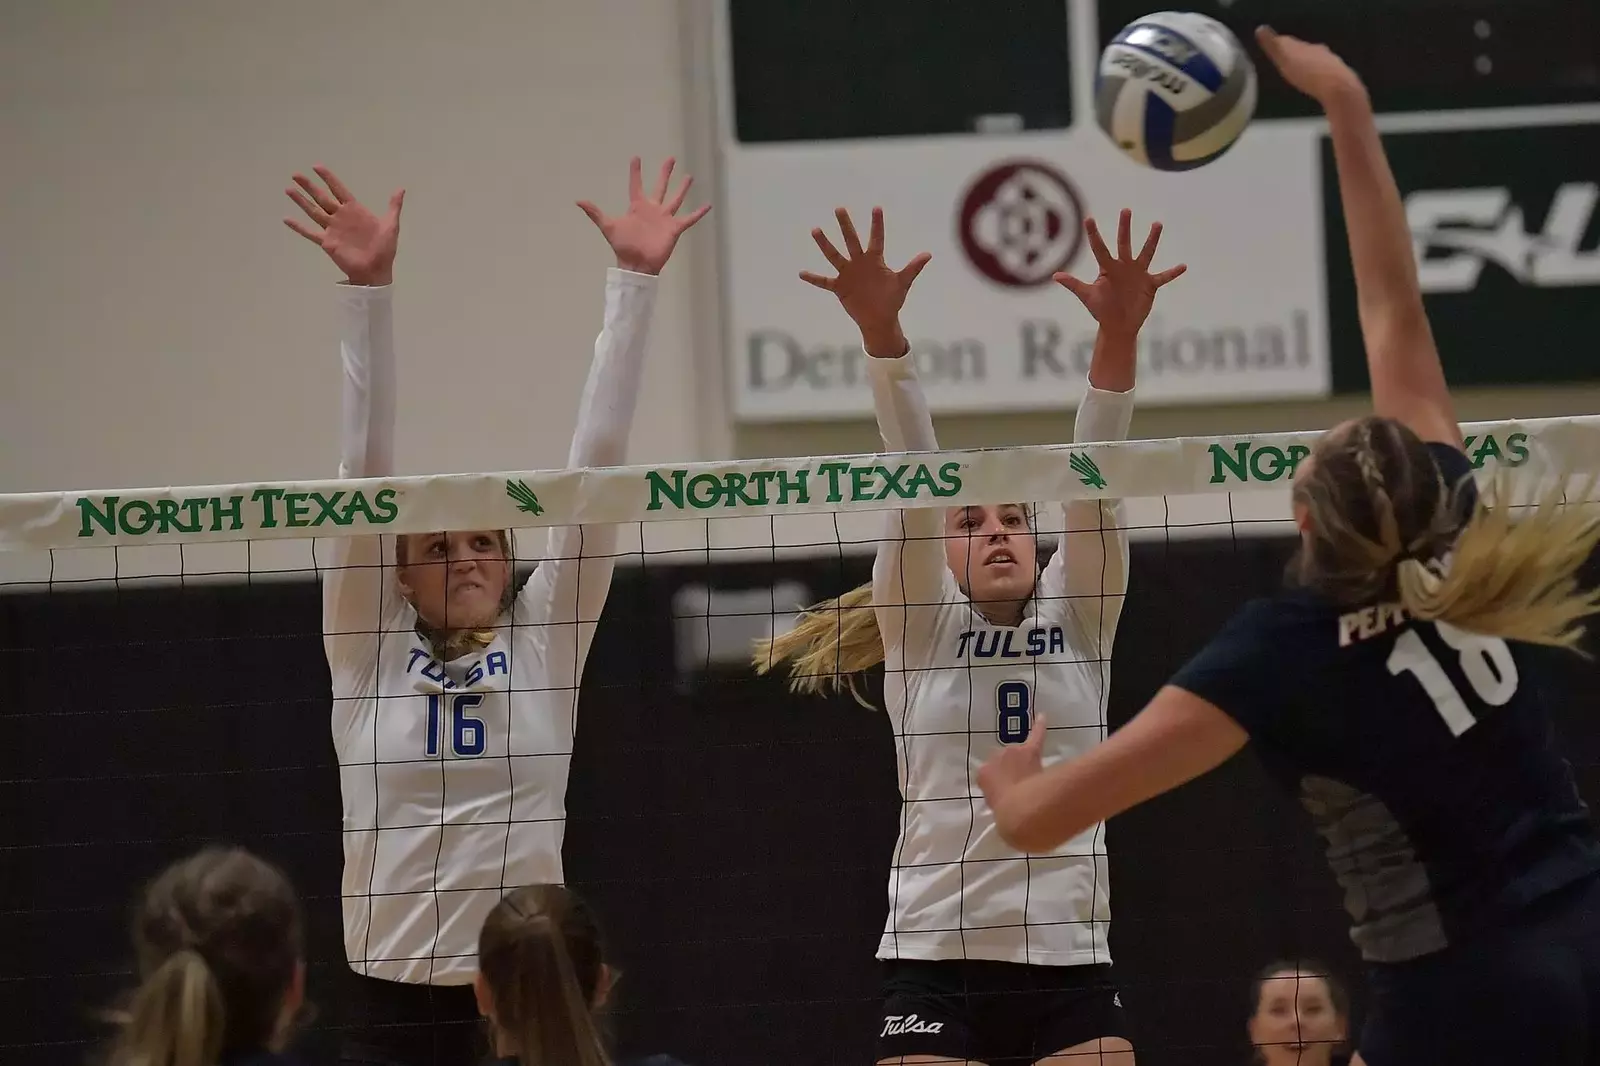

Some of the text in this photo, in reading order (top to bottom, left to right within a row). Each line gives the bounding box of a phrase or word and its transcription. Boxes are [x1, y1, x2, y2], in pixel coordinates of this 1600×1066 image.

[644, 461, 963, 510] NORTH TEXAS
[75, 488, 398, 537] NORTH TEXAS
[956, 626, 1065, 659] TULSA
[424, 692, 487, 758] 16
[996, 680, 1032, 746] 8
[880, 1013, 944, 1037] Tulsa
